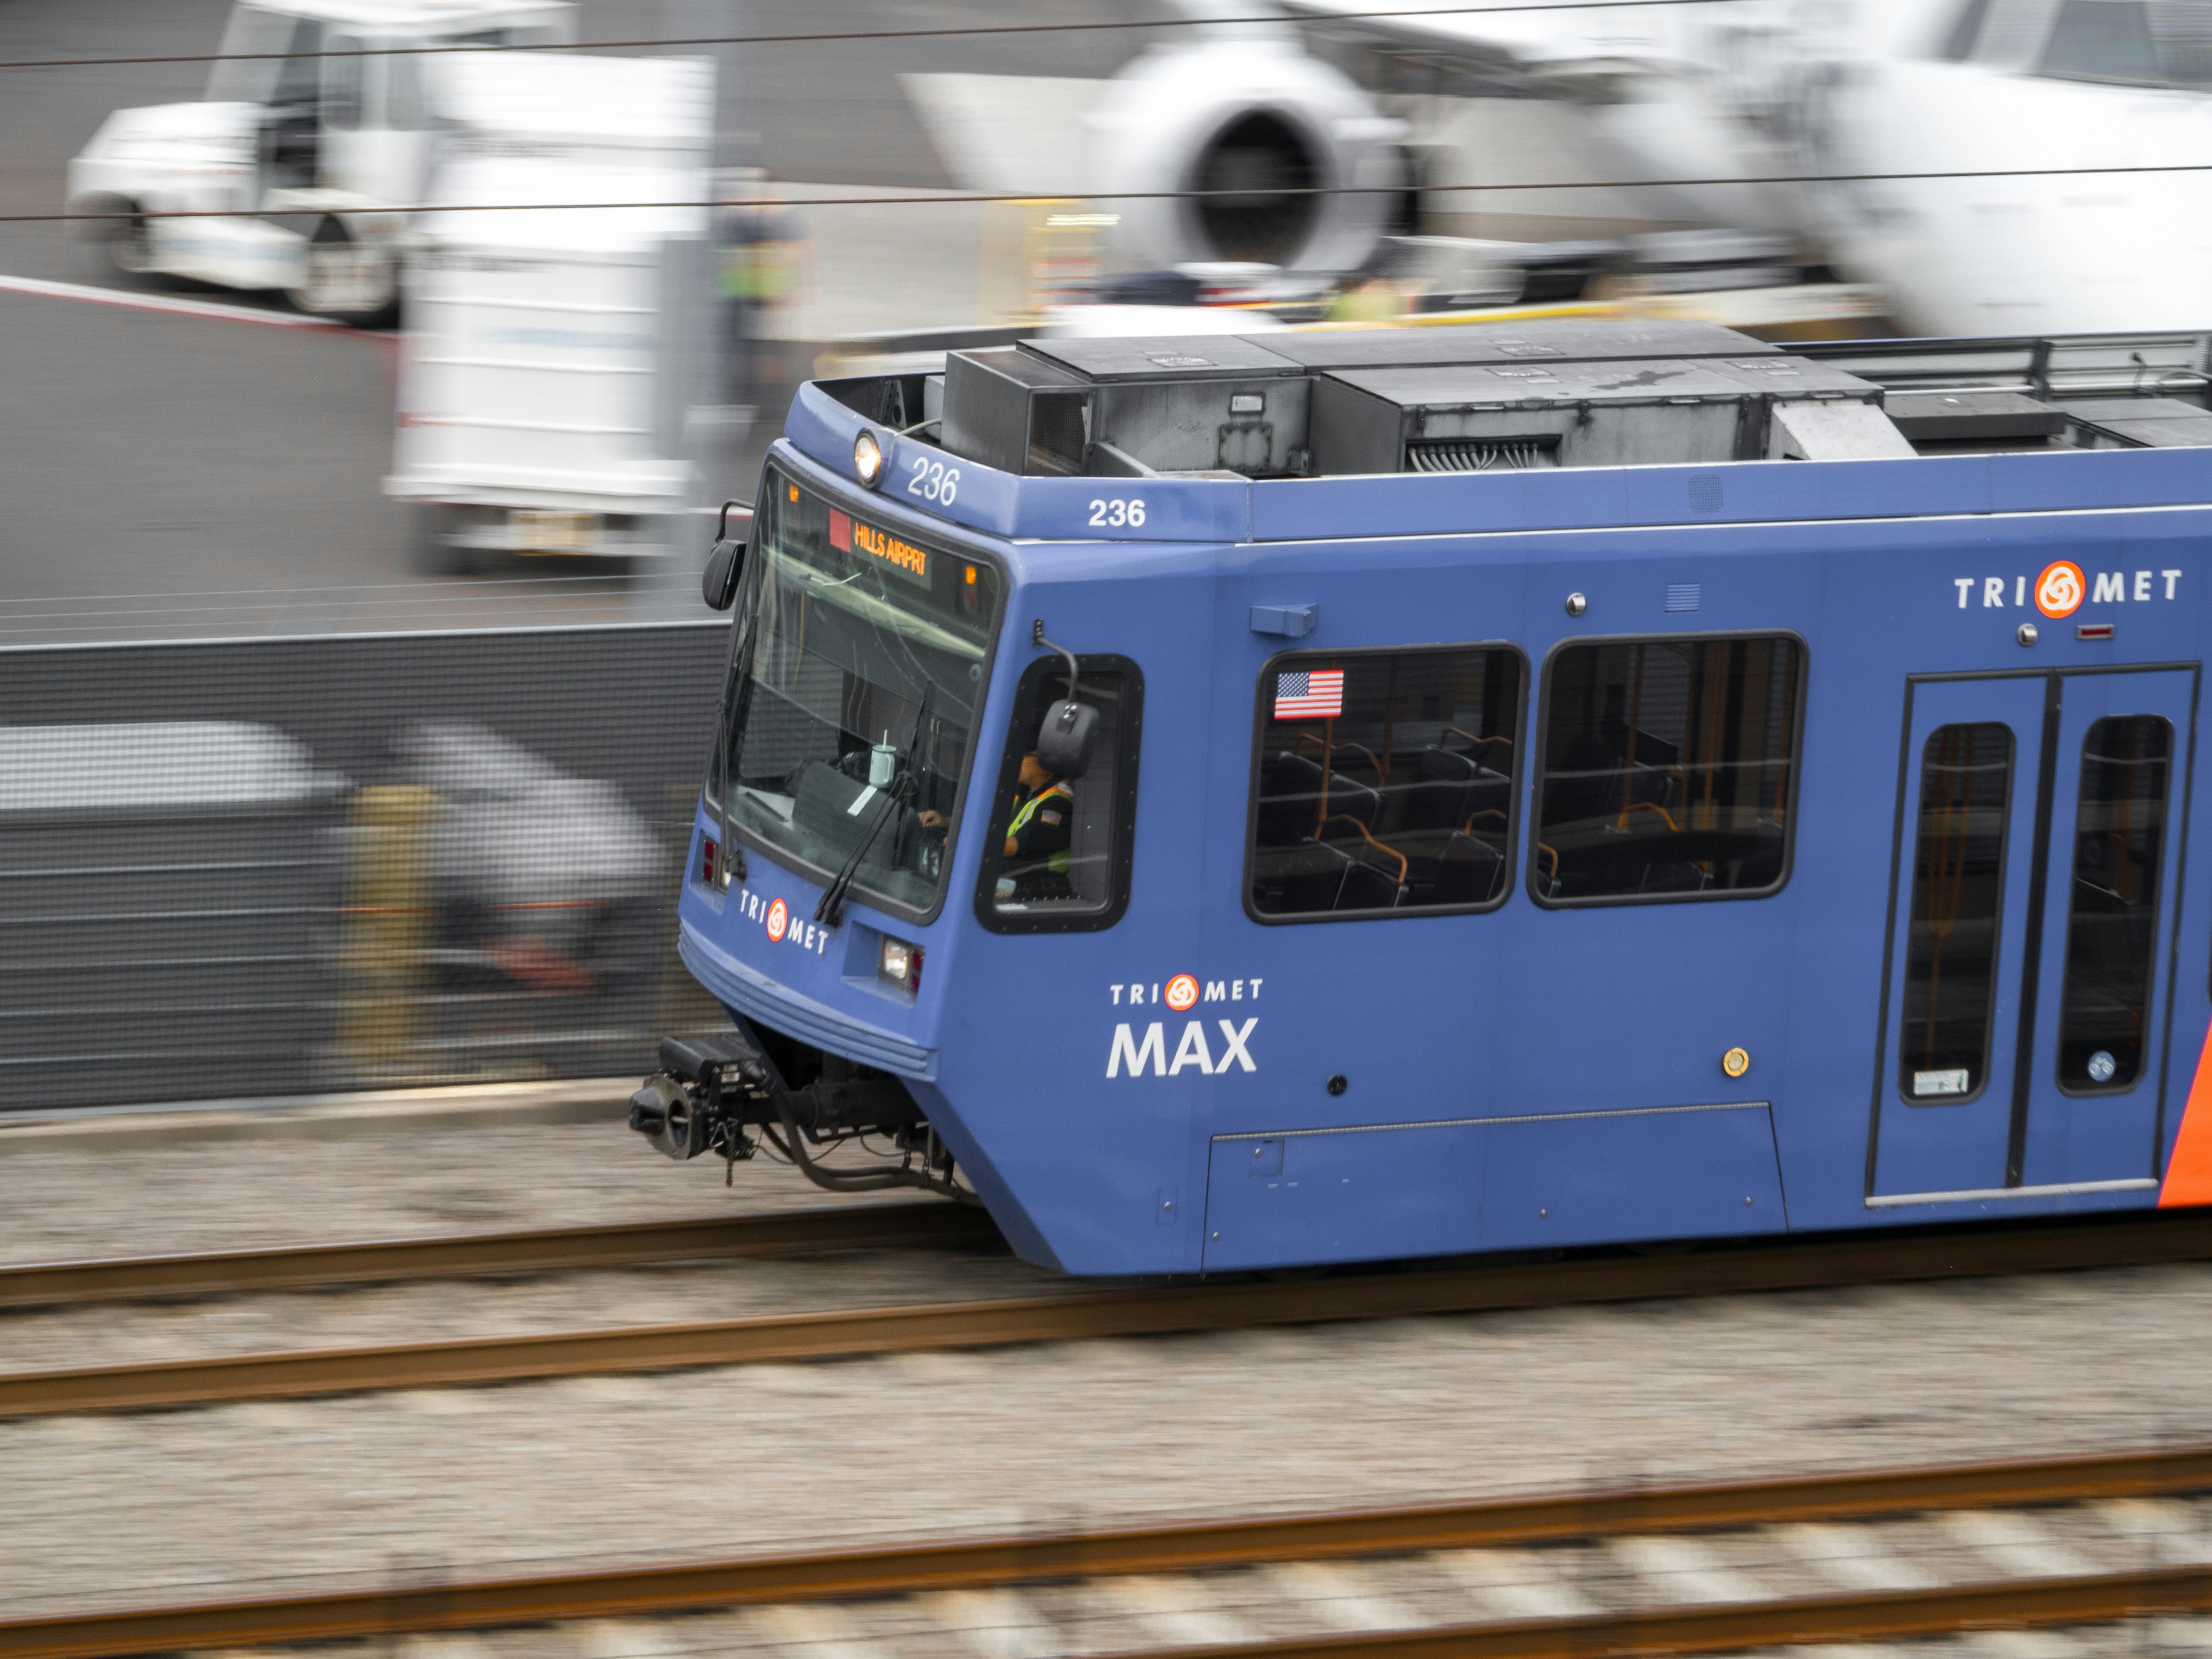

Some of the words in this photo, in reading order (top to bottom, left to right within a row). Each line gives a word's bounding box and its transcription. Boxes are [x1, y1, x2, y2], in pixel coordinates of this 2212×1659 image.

[907, 456, 960, 506] 236
[1088, 499, 1146, 527] 236
[854, 522, 885, 557] HILLS
[1954, 576, 2026, 608] TRI
[2092, 569, 2182, 603] MET
[740, 888, 767, 924] TRI
[787, 916, 829, 954] MET
[1110, 983, 1159, 1005] TRI
[1204, 978, 1263, 1002] MET
[1106, 1017, 1259, 1079] MAX
